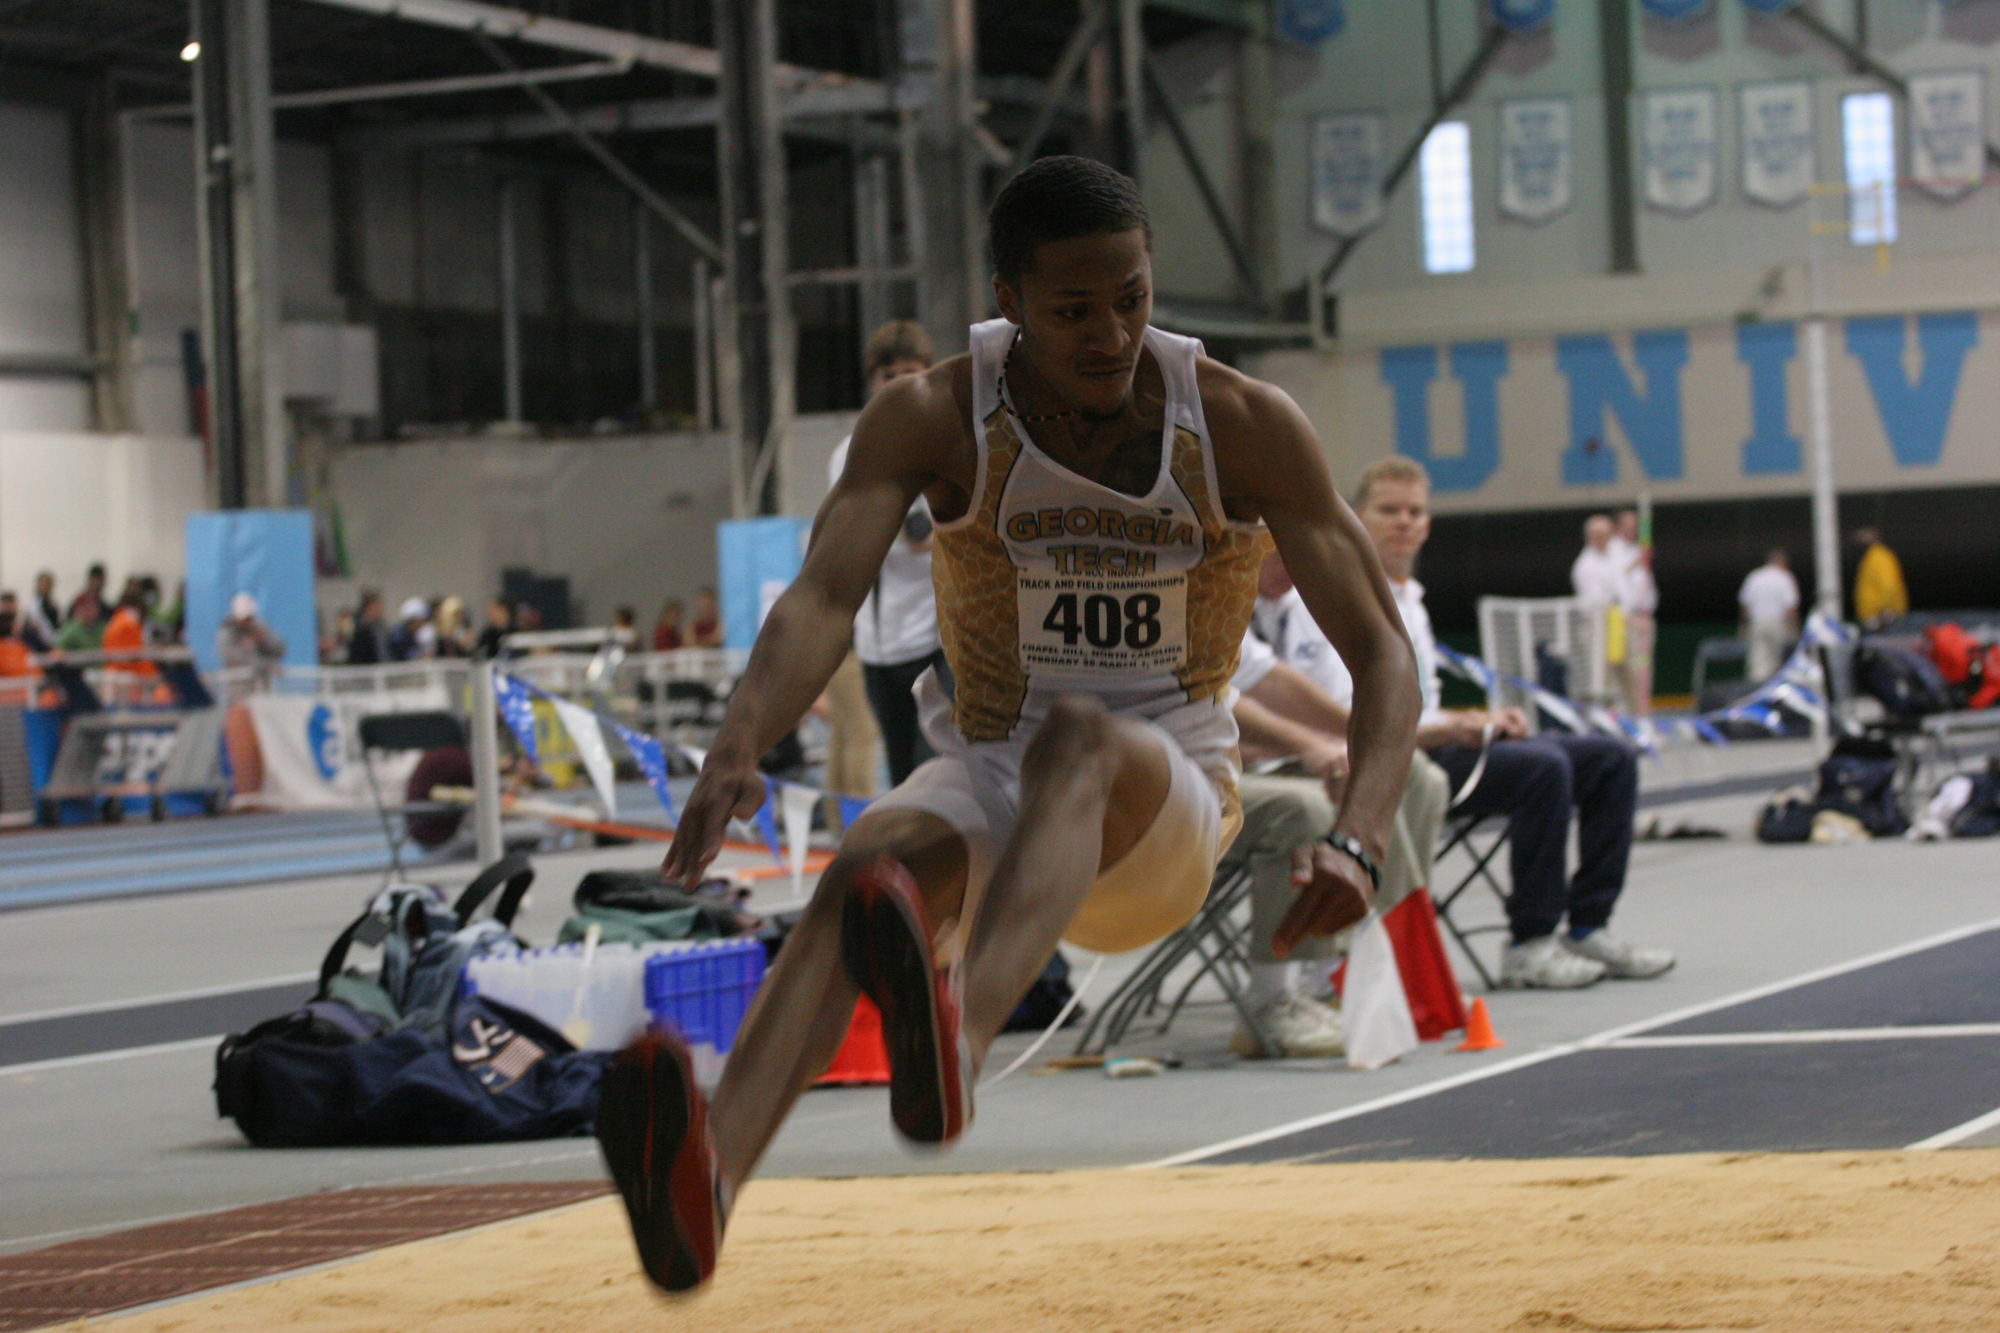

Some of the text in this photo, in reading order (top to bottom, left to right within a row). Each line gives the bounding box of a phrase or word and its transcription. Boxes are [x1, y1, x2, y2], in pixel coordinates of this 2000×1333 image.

[1380, 312, 1979, 491] UNIV
[1006, 506, 1194, 546] GEORGIA
[1047, 544, 1156, 572] TECH
[1019, 576, 1185, 591] TRACK AND FIELD CHAMPIONSHIPS
[1042, 592, 1162, 650] 408
[1022, 643, 1059, 655] CHAPEL
[1091, 649, 1127, 660] NORTH
[1131, 646, 1182, 659] CAROLINA
[1026, 653, 1079, 667] FEBRUARY
